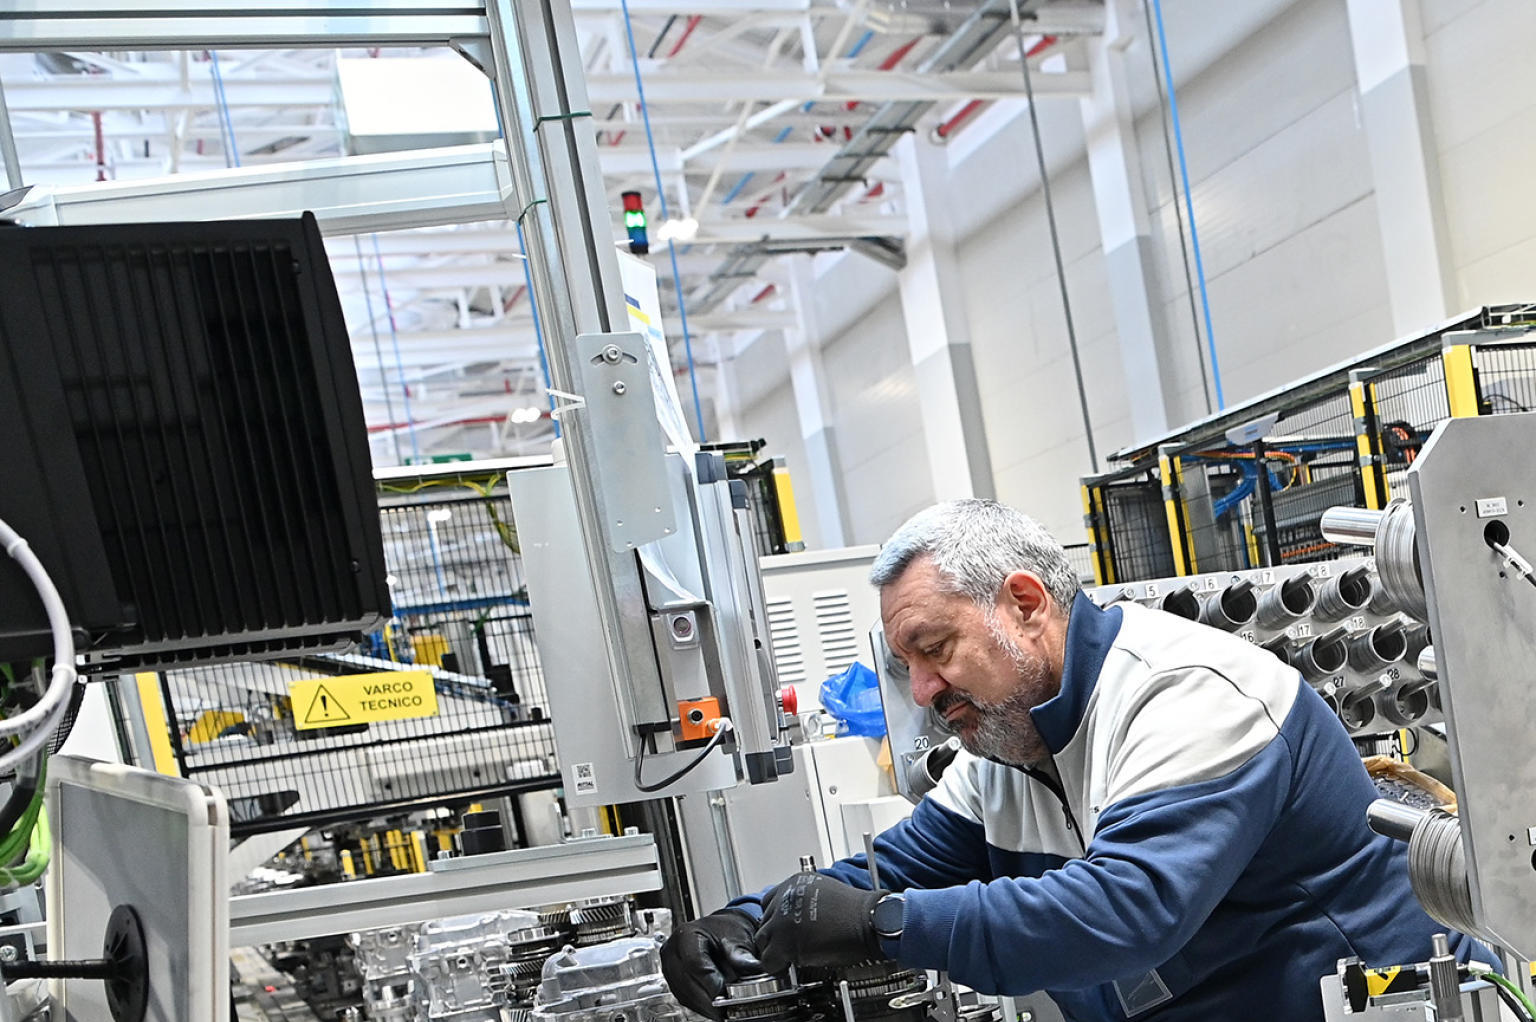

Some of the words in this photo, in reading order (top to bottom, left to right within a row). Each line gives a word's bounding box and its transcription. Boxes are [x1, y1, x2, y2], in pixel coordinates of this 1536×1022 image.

[1265, 572, 1271, 582] 7
[1207, 578, 1215, 589] 6
[1148, 585, 1156, 597] 5
[1299, 624, 1310, 636] 17
[1242, 631, 1254, 642] 16
[1386, 668, 1400, 680] 28
[1333, 675, 1344, 688] 27
[363, 681, 413, 695] VARCO
[360, 695, 422, 711] TECNICO
[914, 737, 929, 750] 20
